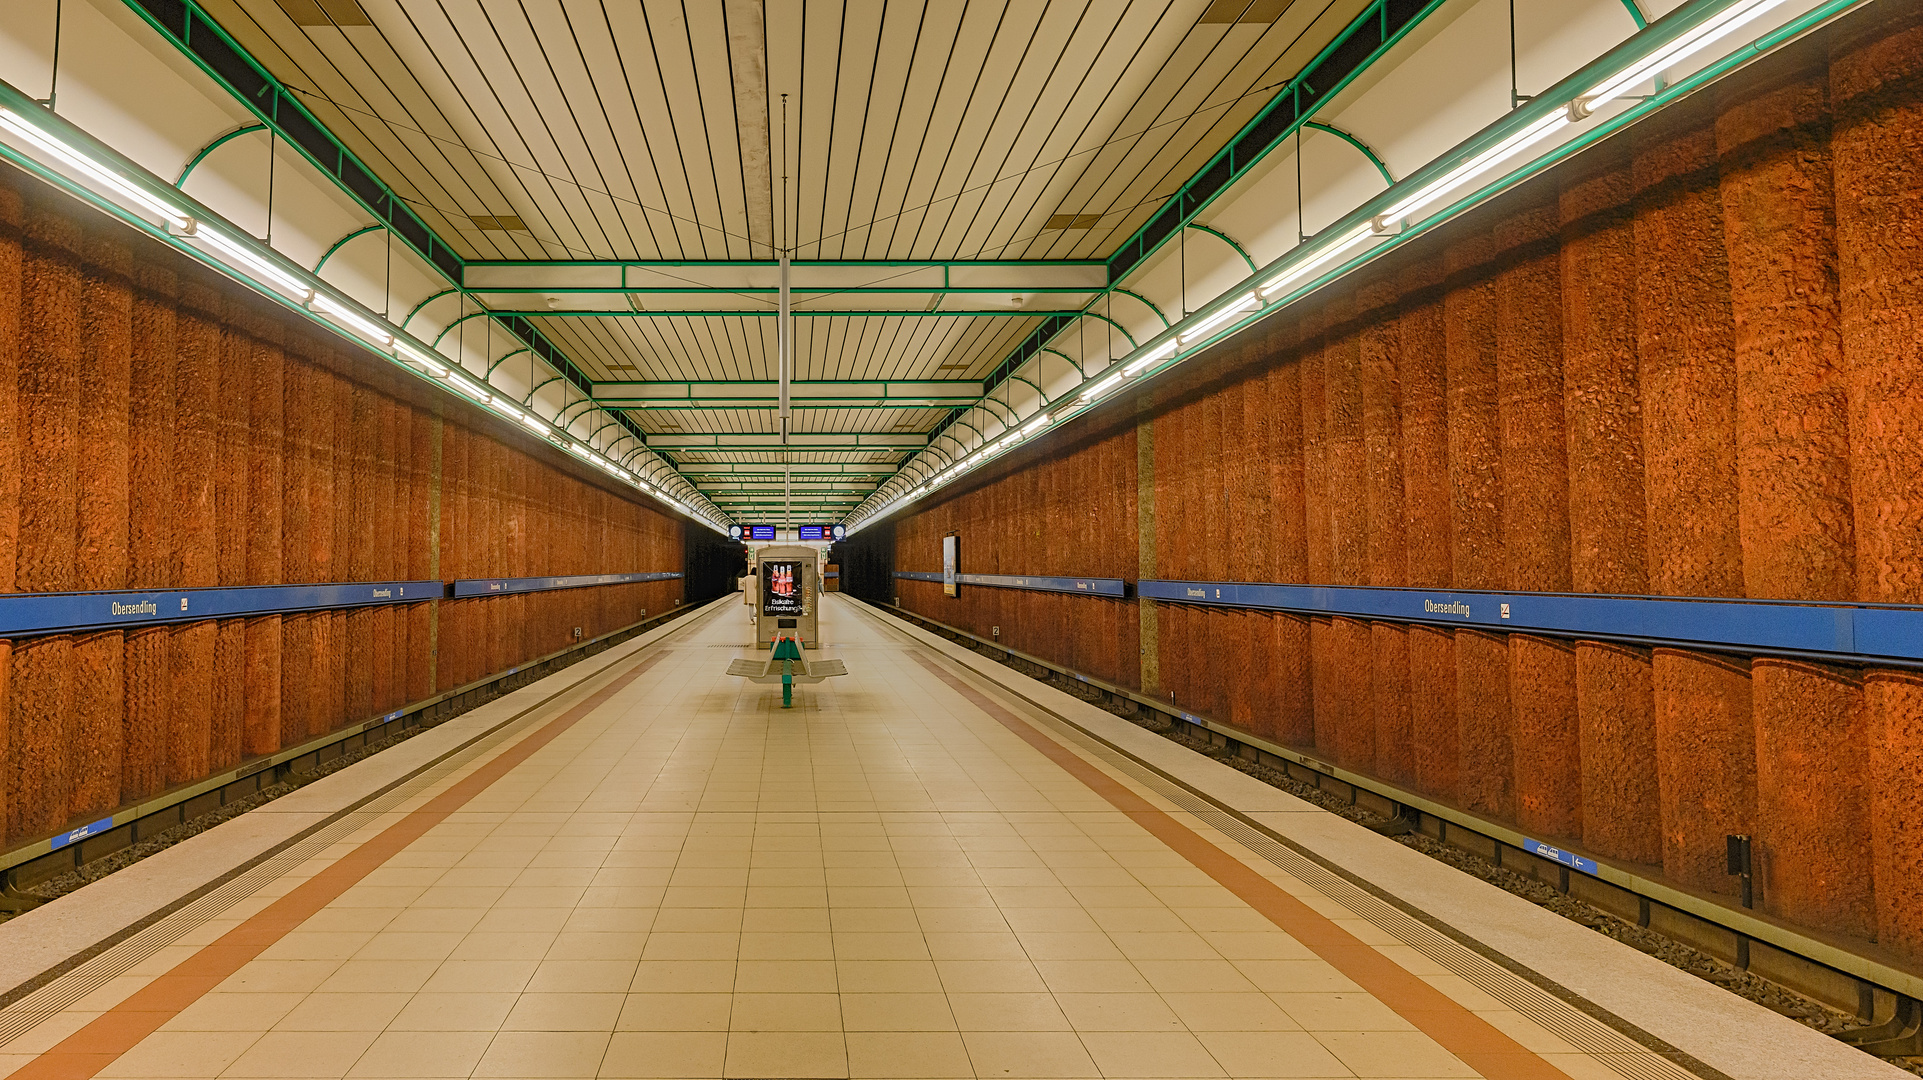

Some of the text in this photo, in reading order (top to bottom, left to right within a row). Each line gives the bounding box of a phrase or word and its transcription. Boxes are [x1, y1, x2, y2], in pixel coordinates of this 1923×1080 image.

[111, 600, 157, 616] Obersendling
[1424, 598, 1470, 618] Obersendling
[575, 628, 581, 636] 2
[993, 627, 999, 635] 2
